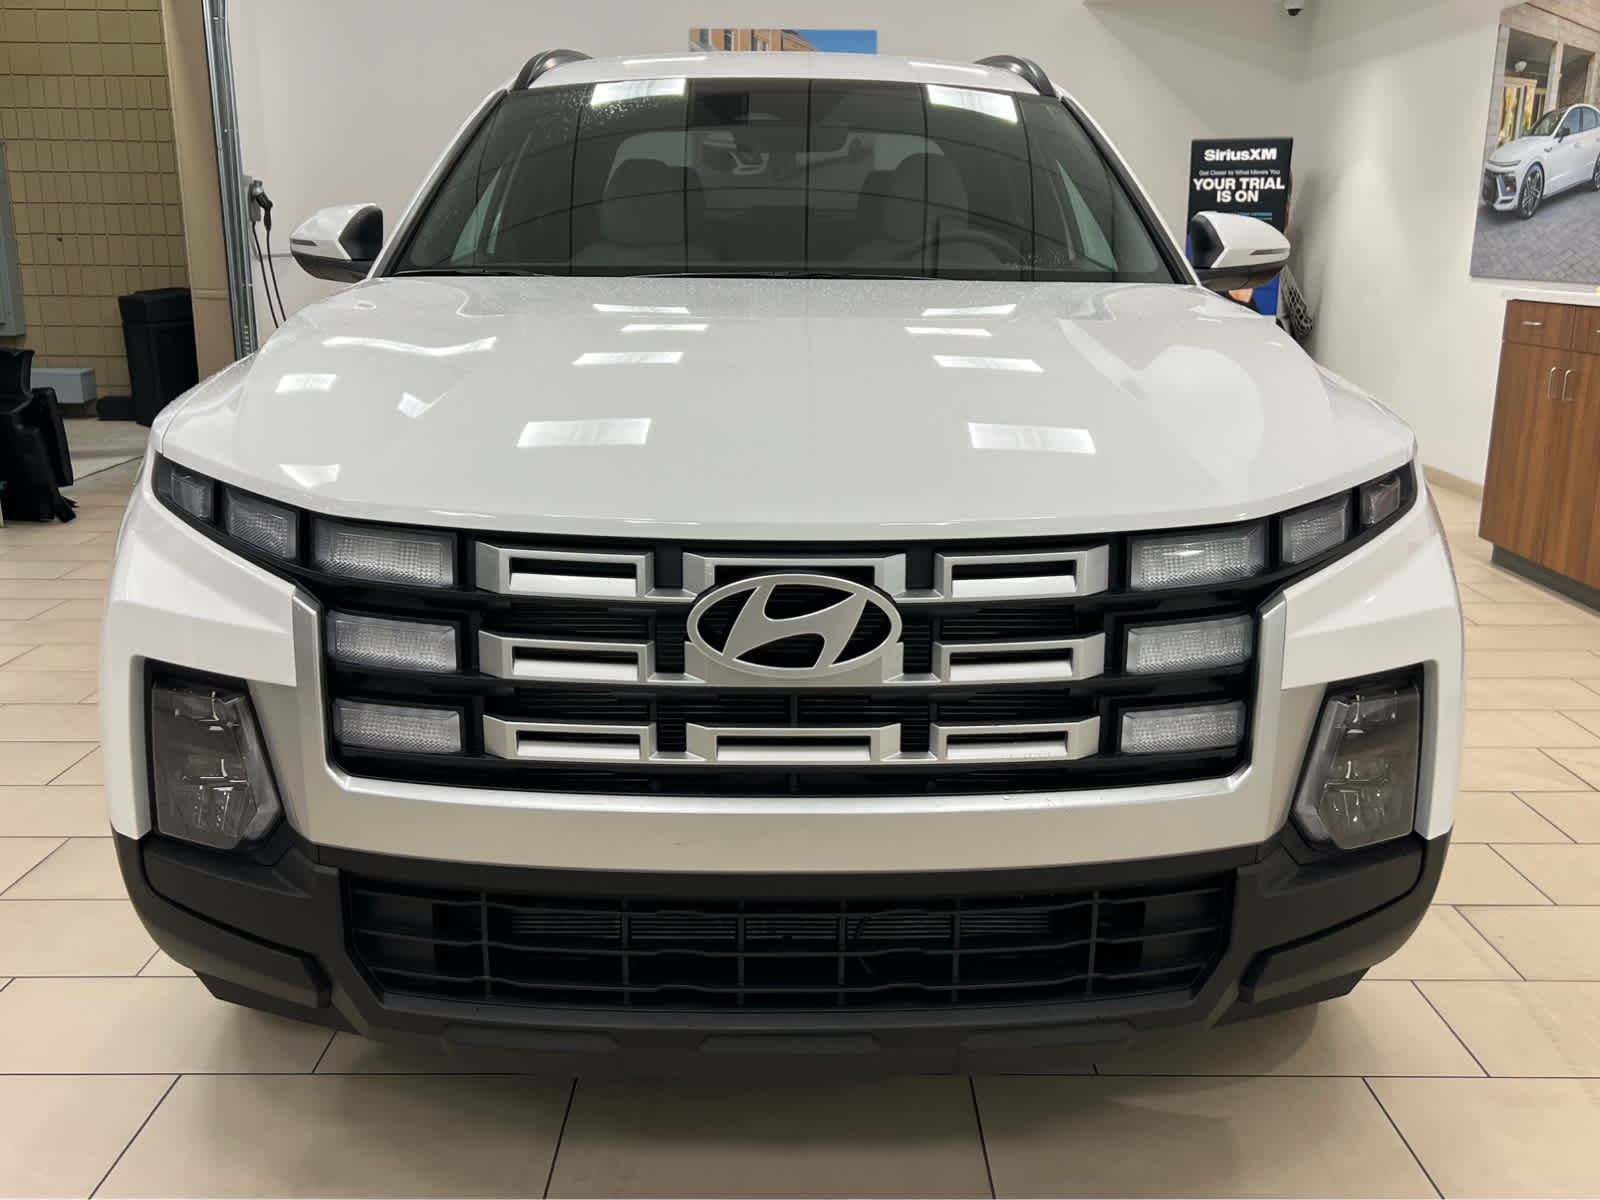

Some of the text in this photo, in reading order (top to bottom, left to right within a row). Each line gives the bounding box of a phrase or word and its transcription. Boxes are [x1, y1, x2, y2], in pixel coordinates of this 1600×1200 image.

[1204, 148, 1278, 161] SiriusXM
[1193, 177, 1285, 191] YOUR TRIAL
[1216, 190, 1259, 203] IS ON
